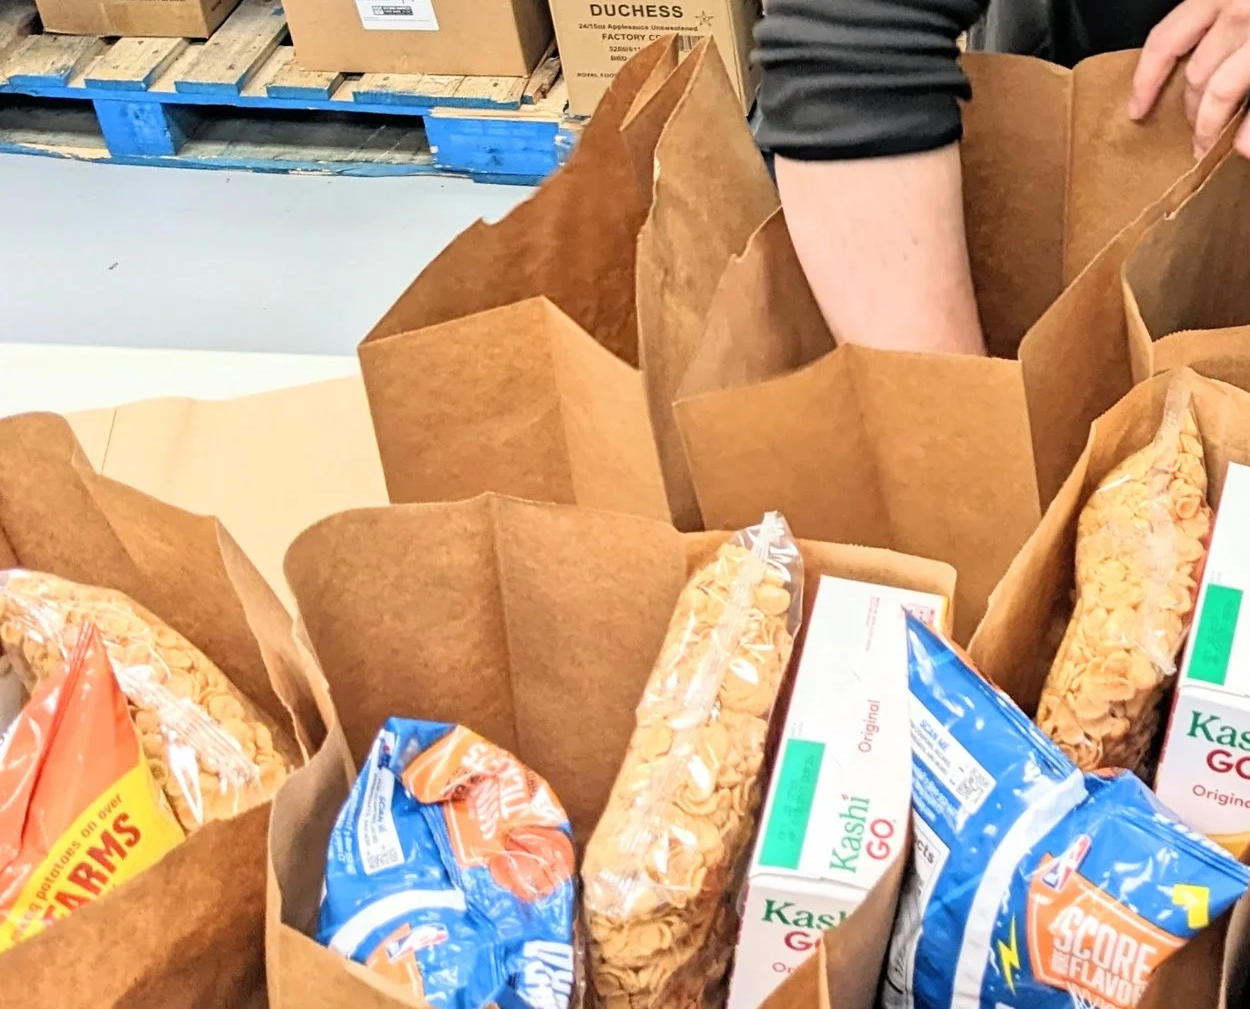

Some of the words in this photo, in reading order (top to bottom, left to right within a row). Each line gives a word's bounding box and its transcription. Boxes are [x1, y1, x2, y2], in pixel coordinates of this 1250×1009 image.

[589, 3, 684, 18] DUCHESS
[607, 23, 649, 32] Applesauce
[602, 33, 646, 41] FACTORY
[858, 699, 880, 753] Original
[36, 840, 81, 902] potatoes
[81, 821, 98, 838] on
[98, 793, 123, 820] over
[829, 794, 871, 874] Kashi
[866, 818, 895, 861] GO
[915, 839, 936, 866] cts
[1053, 906, 1157, 984] SCORE
